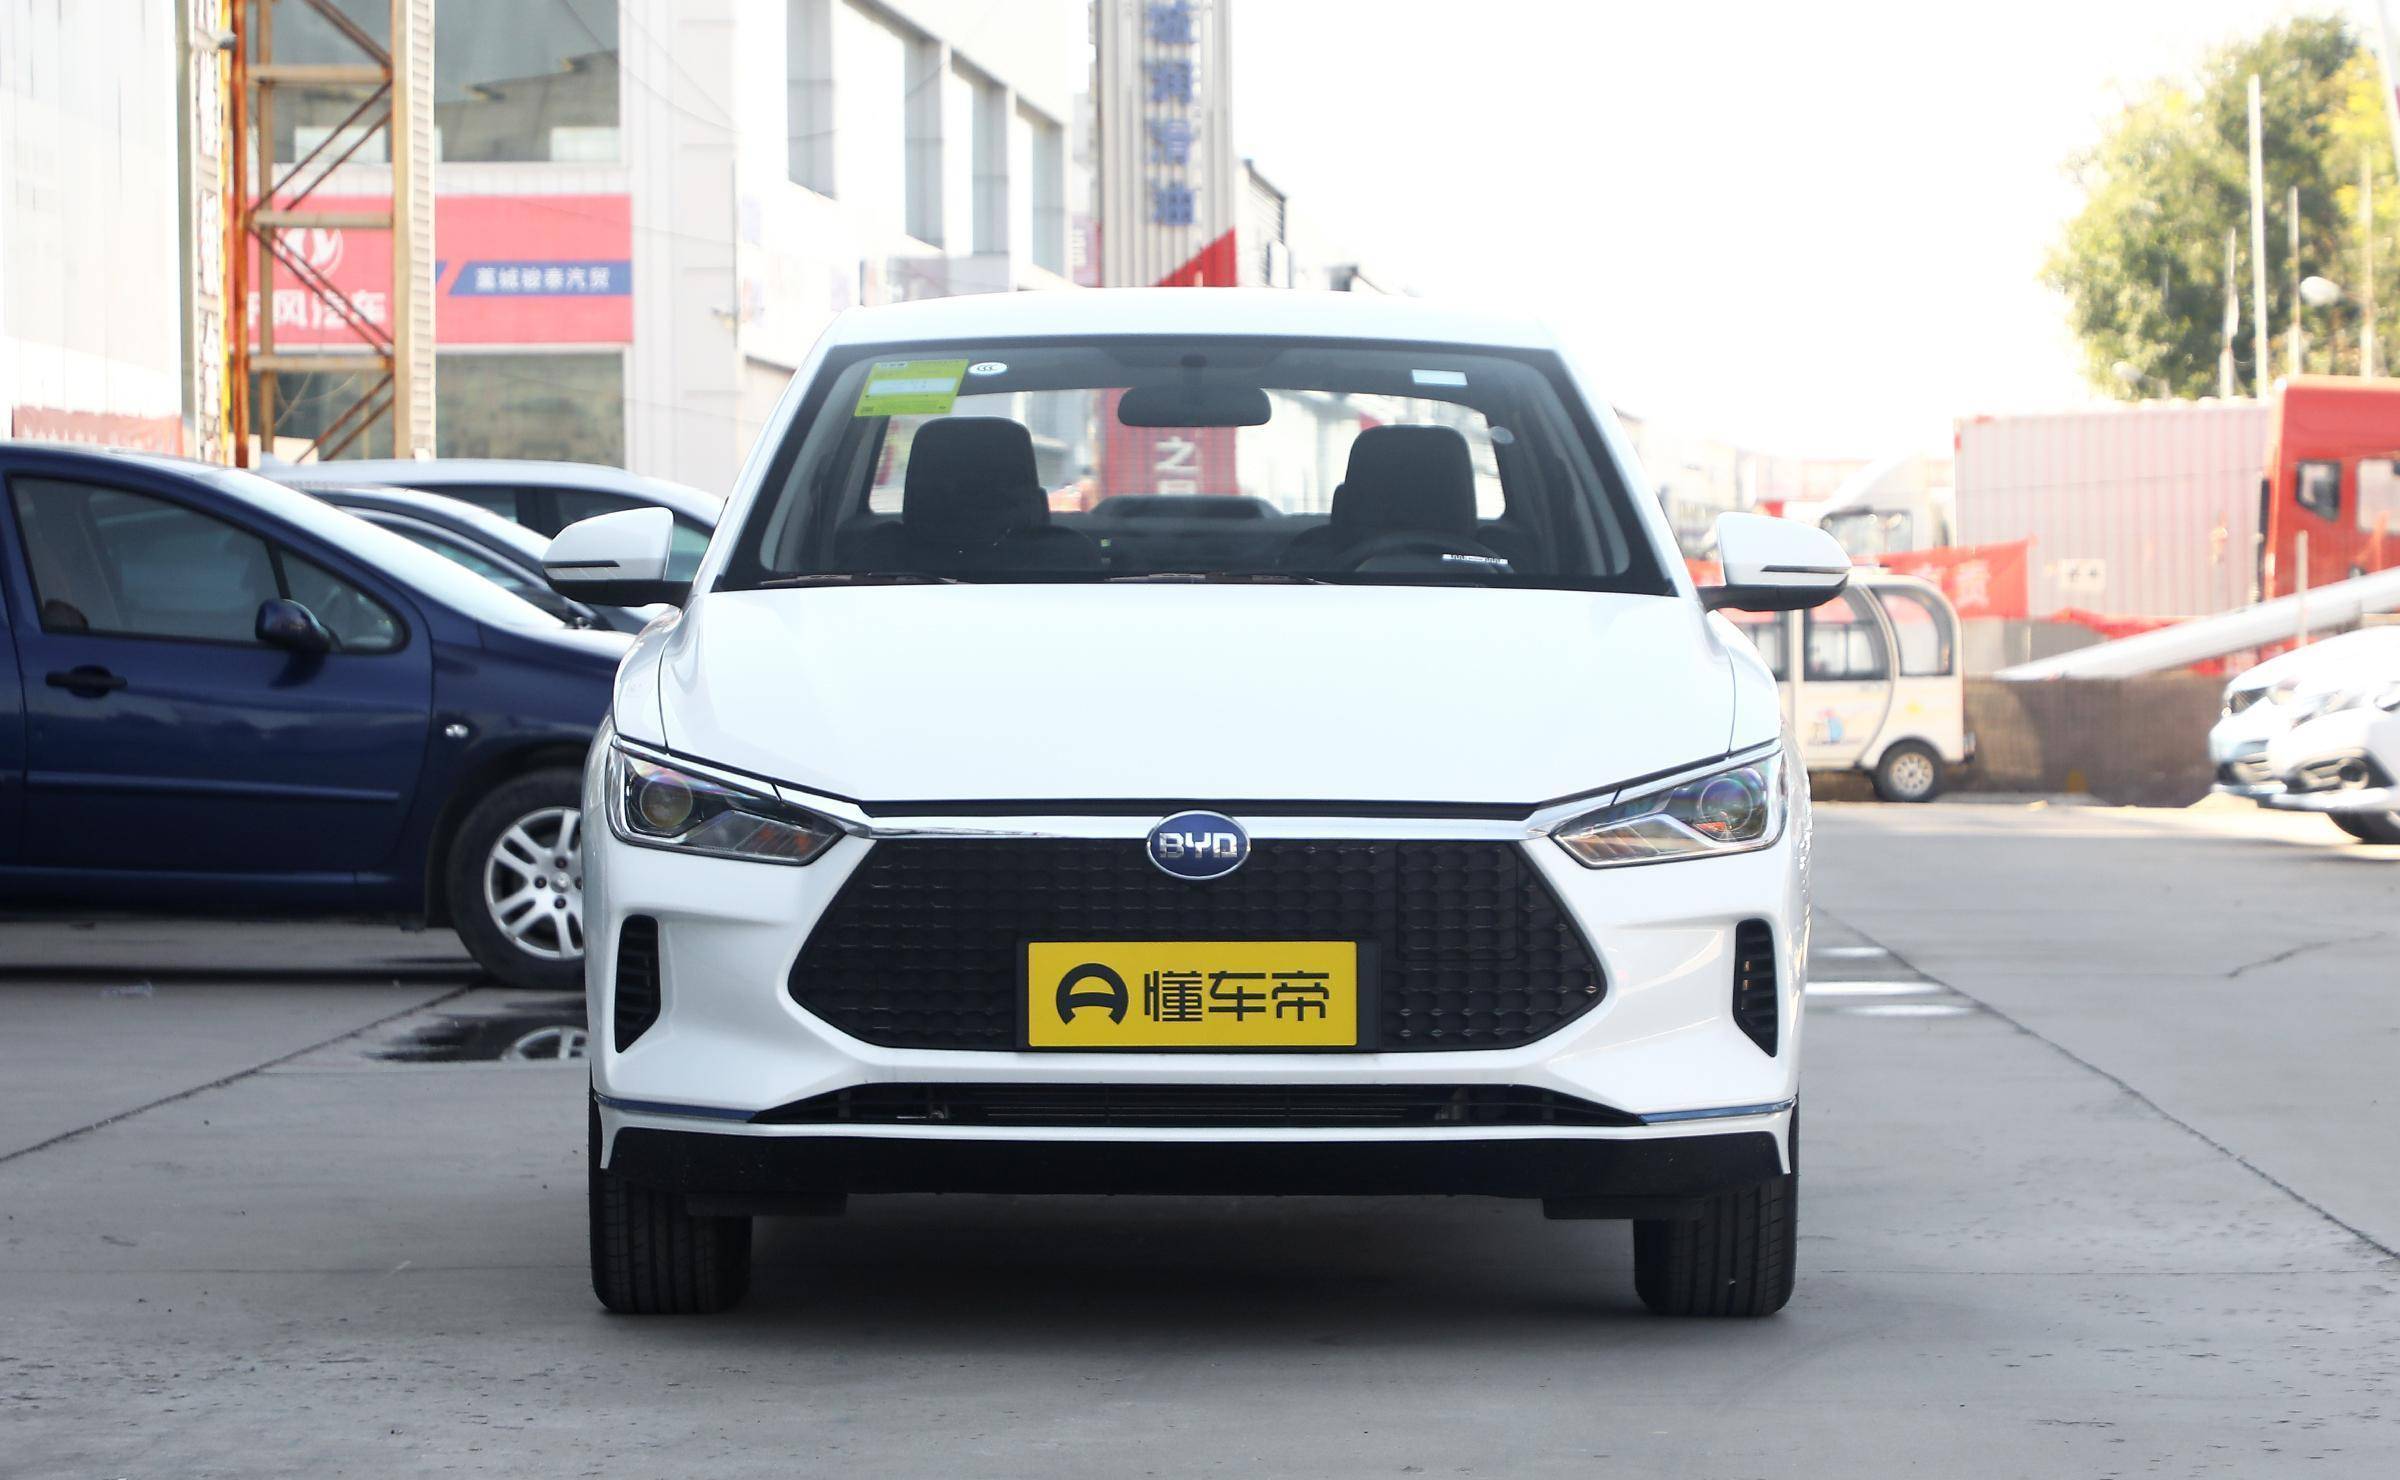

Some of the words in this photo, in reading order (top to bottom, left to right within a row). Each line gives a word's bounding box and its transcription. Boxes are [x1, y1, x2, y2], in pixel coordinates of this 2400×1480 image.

[1159, 832, 1238, 859] BYD
[1144, 970, 1330, 1022] 懂车帝
